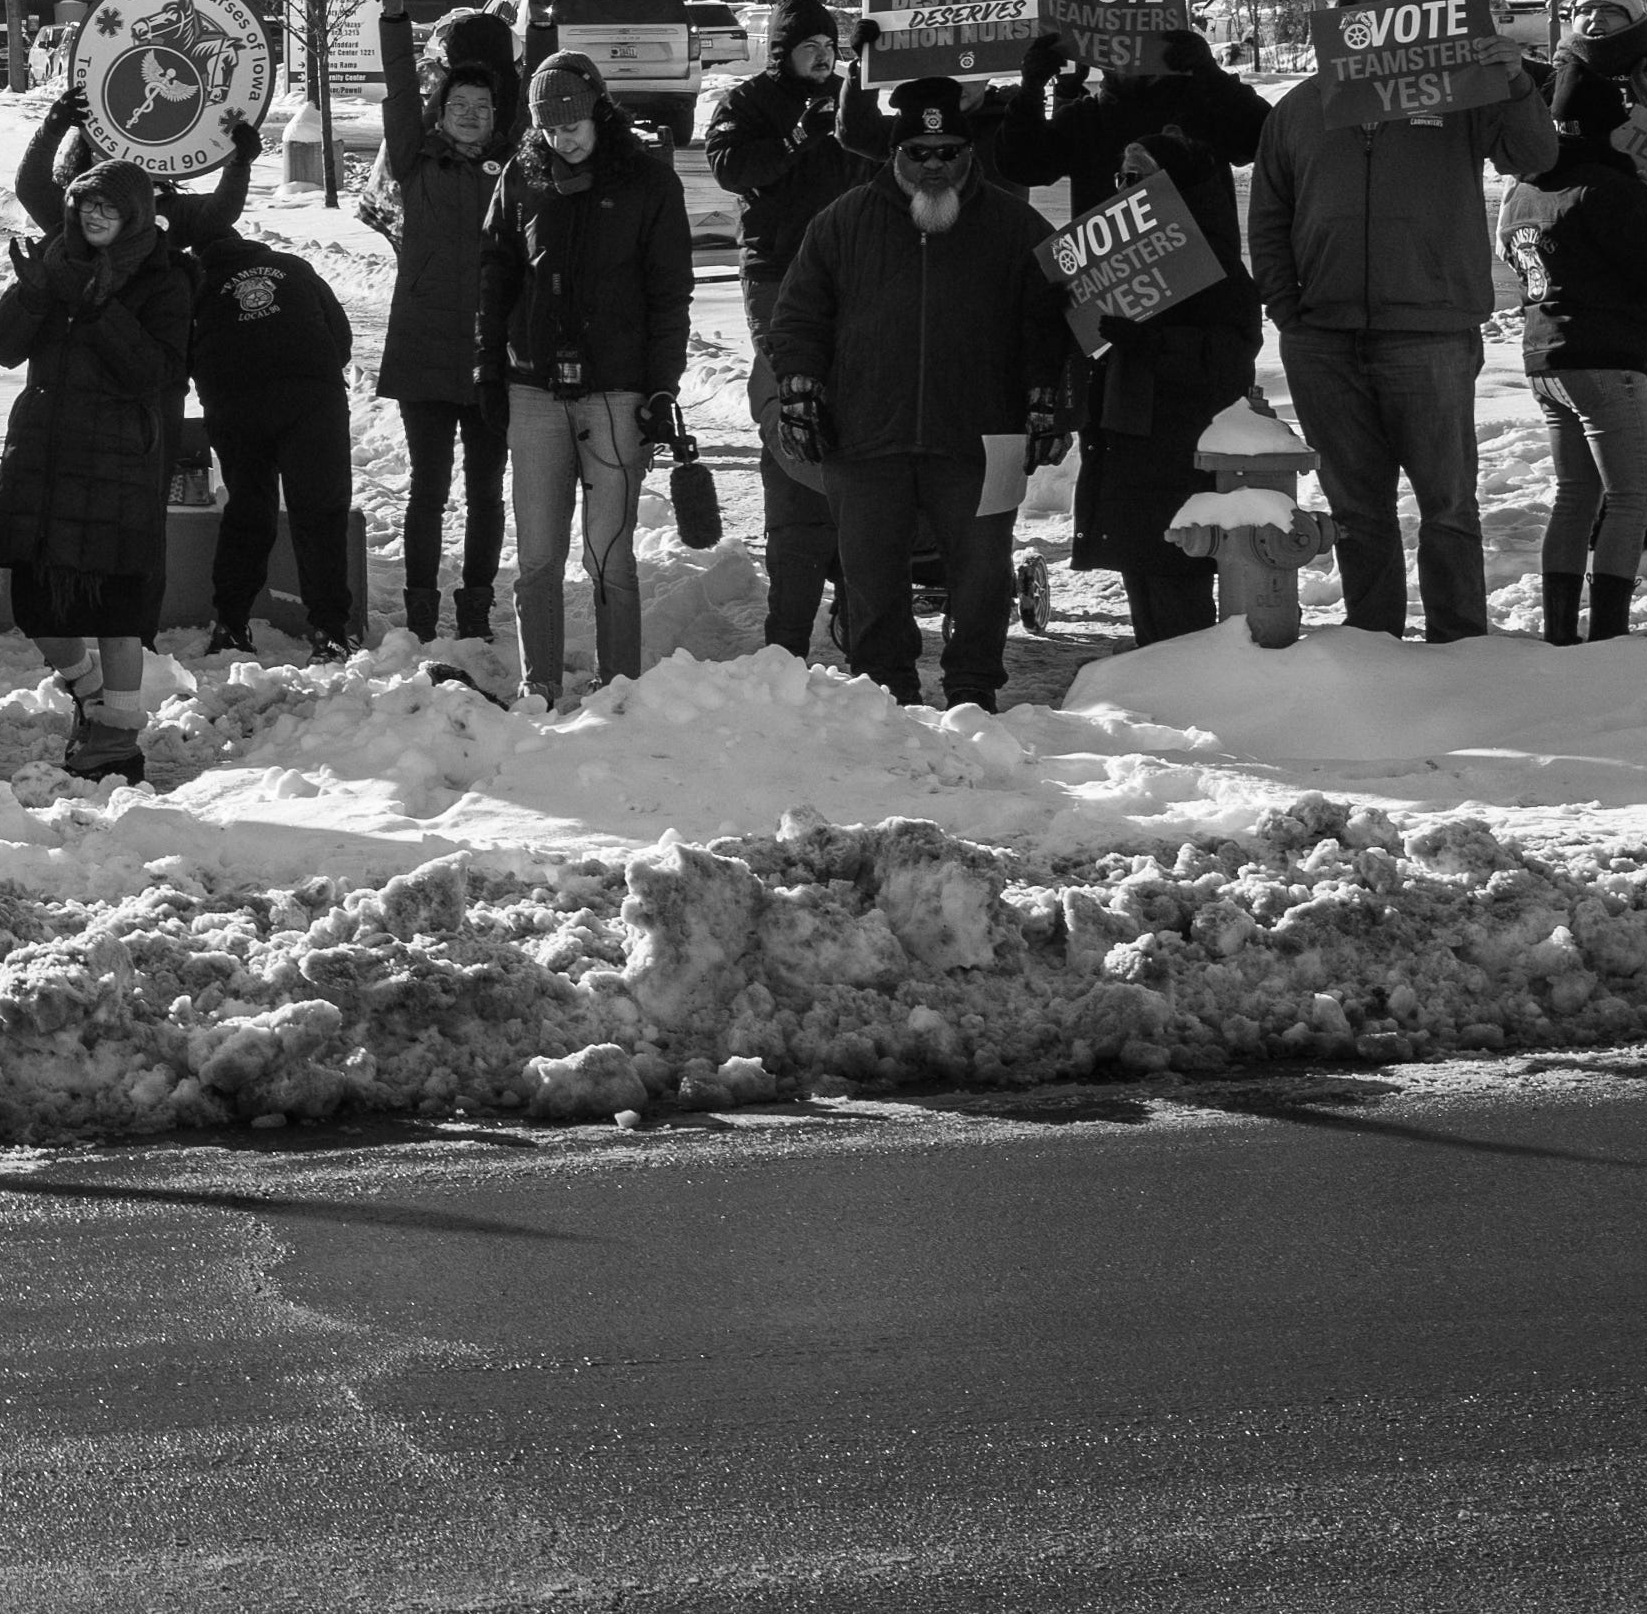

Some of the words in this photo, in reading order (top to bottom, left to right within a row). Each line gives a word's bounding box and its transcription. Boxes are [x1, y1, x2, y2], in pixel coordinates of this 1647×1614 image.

[908, 0, 1028, 29] DESERVES
[248, 32, 265, 51] of
[875, 26, 954, 51] UNION
[1073, 29, 1143, 68] YES!
[249, 56, 266, 101] Iowa
[1373, 70, 1454, 112] YES!
[182, 150, 207, 169] 90
[1062, 188, 1158, 269] VOTE
